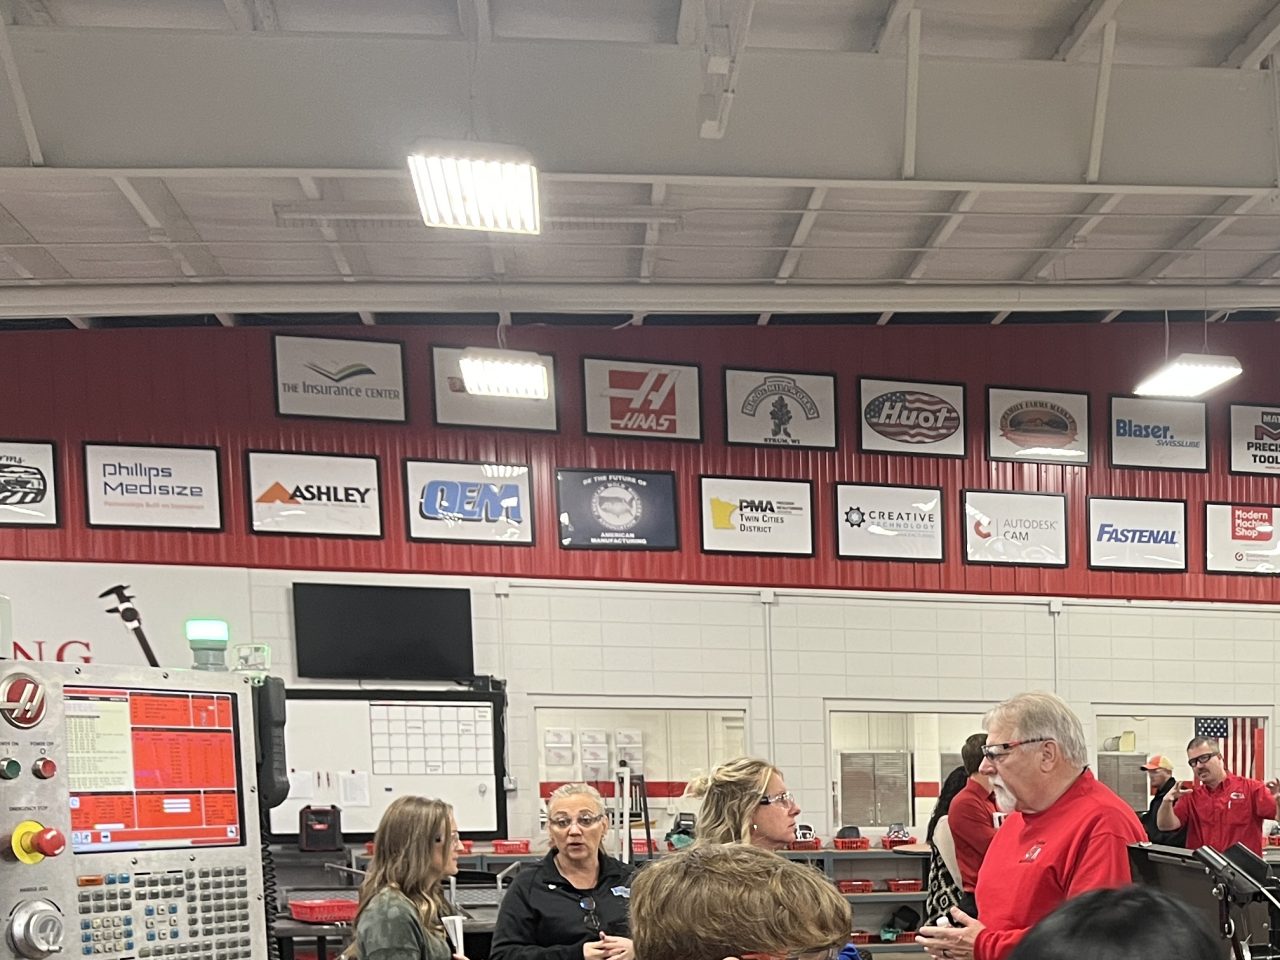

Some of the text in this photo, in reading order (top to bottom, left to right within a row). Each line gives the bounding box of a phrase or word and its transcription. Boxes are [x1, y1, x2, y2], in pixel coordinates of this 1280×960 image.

[282, 380, 400, 400] THE Insurance CENTER
[618, 411, 671, 431] HAAS
[878, 401, 948, 428] Huot
[289, 484, 371, 504] ASHLEY
[419, 479, 523, 525] OEM
[739, 498, 776, 513] PMA
[868, 510, 935, 523] CREATIVE
[1234, 509, 1269, 520] Modern
[1003, 519, 1056, 531] AUTODESK
[600, 531, 635, 539] AMERICAN
[1003, 530, 1029, 542] CAM
[1096, 523, 1179, 545] FASTENAL
[1234, 527, 1259, 539] Shop
[590, 537, 648, 546] MANUFACTURING
